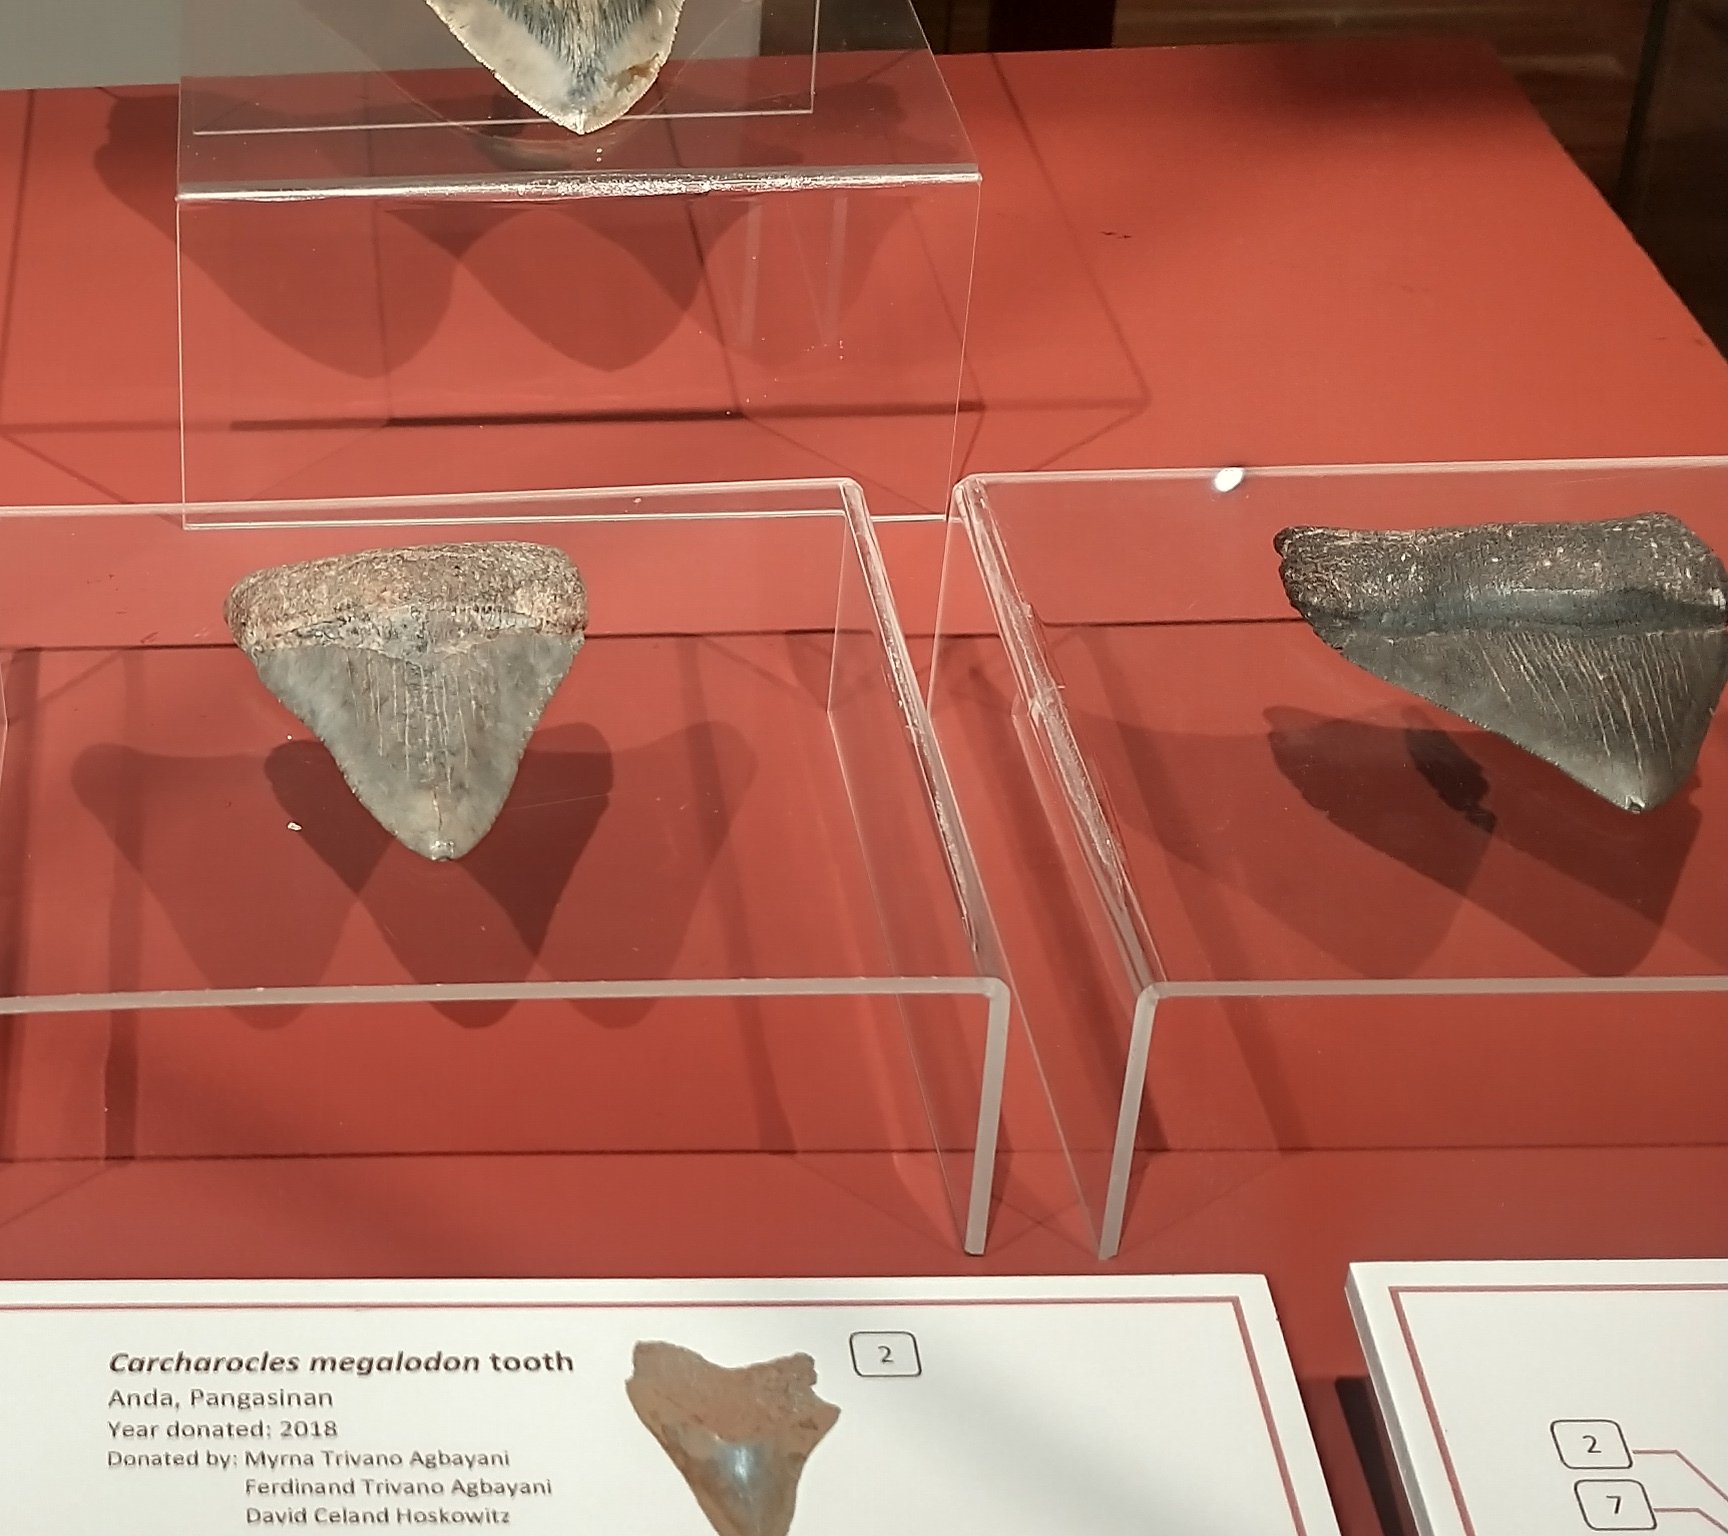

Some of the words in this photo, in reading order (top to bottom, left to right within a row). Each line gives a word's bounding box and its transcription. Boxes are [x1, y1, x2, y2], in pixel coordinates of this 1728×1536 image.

[109, 1350, 300, 1374] Carcharocles
[309, 1350, 480, 1378] megalodon
[489, 1350, 574, 1373] tooth
[877, 1344, 895, 1366] 2
[107, 1387, 180, 1411] Anda,
[190, 1387, 333, 1412] Pangasinan
[108, 1421, 159, 1440] Year
[166, 1419, 271, 1440] donated:
[280, 1420, 338, 1440] 2018
[1582, 1433, 1602, 1454] 2
[107, 1448, 199, 1468] Donated
[206, 1449, 238, 1471] by:
[244, 1449, 315, 1471] Myrna
[321, 1449, 404, 1468] Trivano
[409, 1448, 510, 1471] Agbayani
[245, 1477, 356, 1497] Ferdinand
[361, 1477, 445, 1496] Trivano
[450, 1477, 553, 1499] Agbayani
[246, 1506, 308, 1526] David
[313, 1506, 390, 1525] Celand
[396, 1507, 510, 1526] Hoskowitz
[1605, 1494, 1622, 1516] 7
